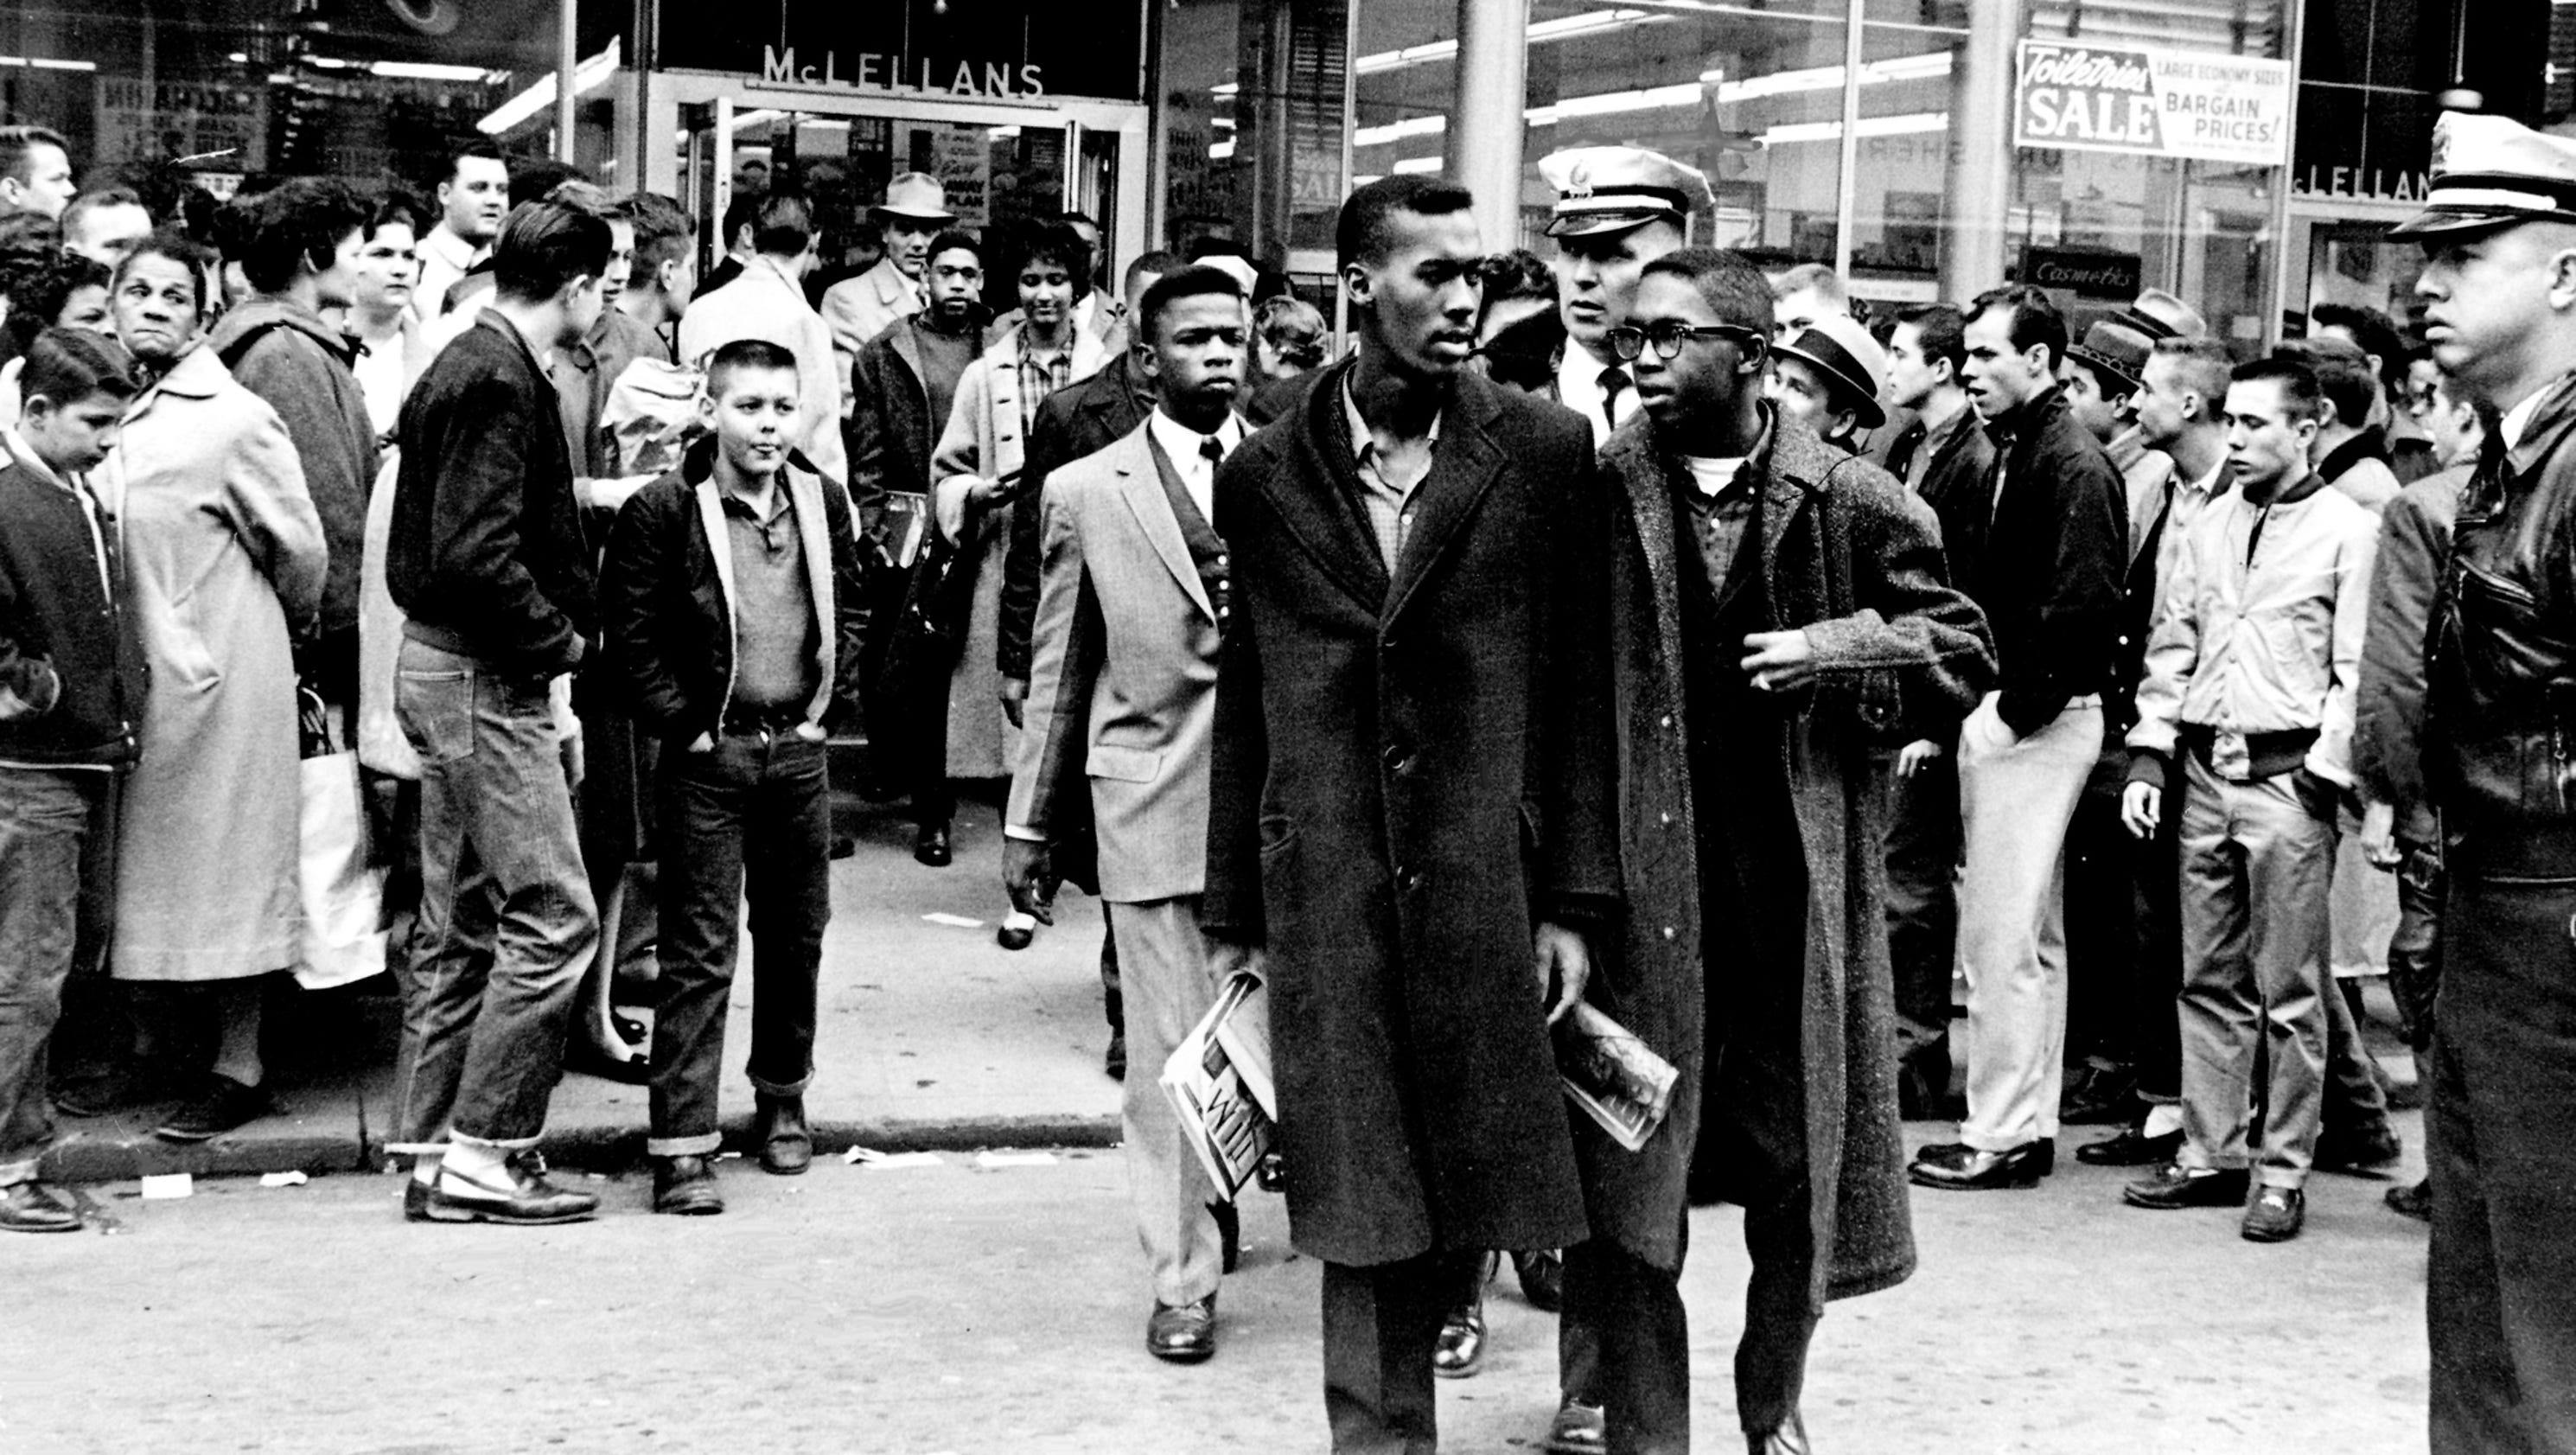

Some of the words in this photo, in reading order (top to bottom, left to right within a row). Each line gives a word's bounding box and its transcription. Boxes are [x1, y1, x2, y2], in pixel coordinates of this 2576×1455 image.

[763, 44, 1044, 99] McLELLANS
[2024, 47, 2150, 93] Toiletries
[2157, 61, 2195, 80] LARGE
[2198, 64, 2251, 82] ECONOMY
[2254, 68, 2285, 86] SIZES
[2026, 87, 2157, 144] SALE
[2165, 91, 2260, 119] BARGAIN
[2194, 115, 2281, 144] PRICES!
[2292, 163, 2431, 203] cLELLAN
[2036, 261, 2133, 287] Cosmetics
